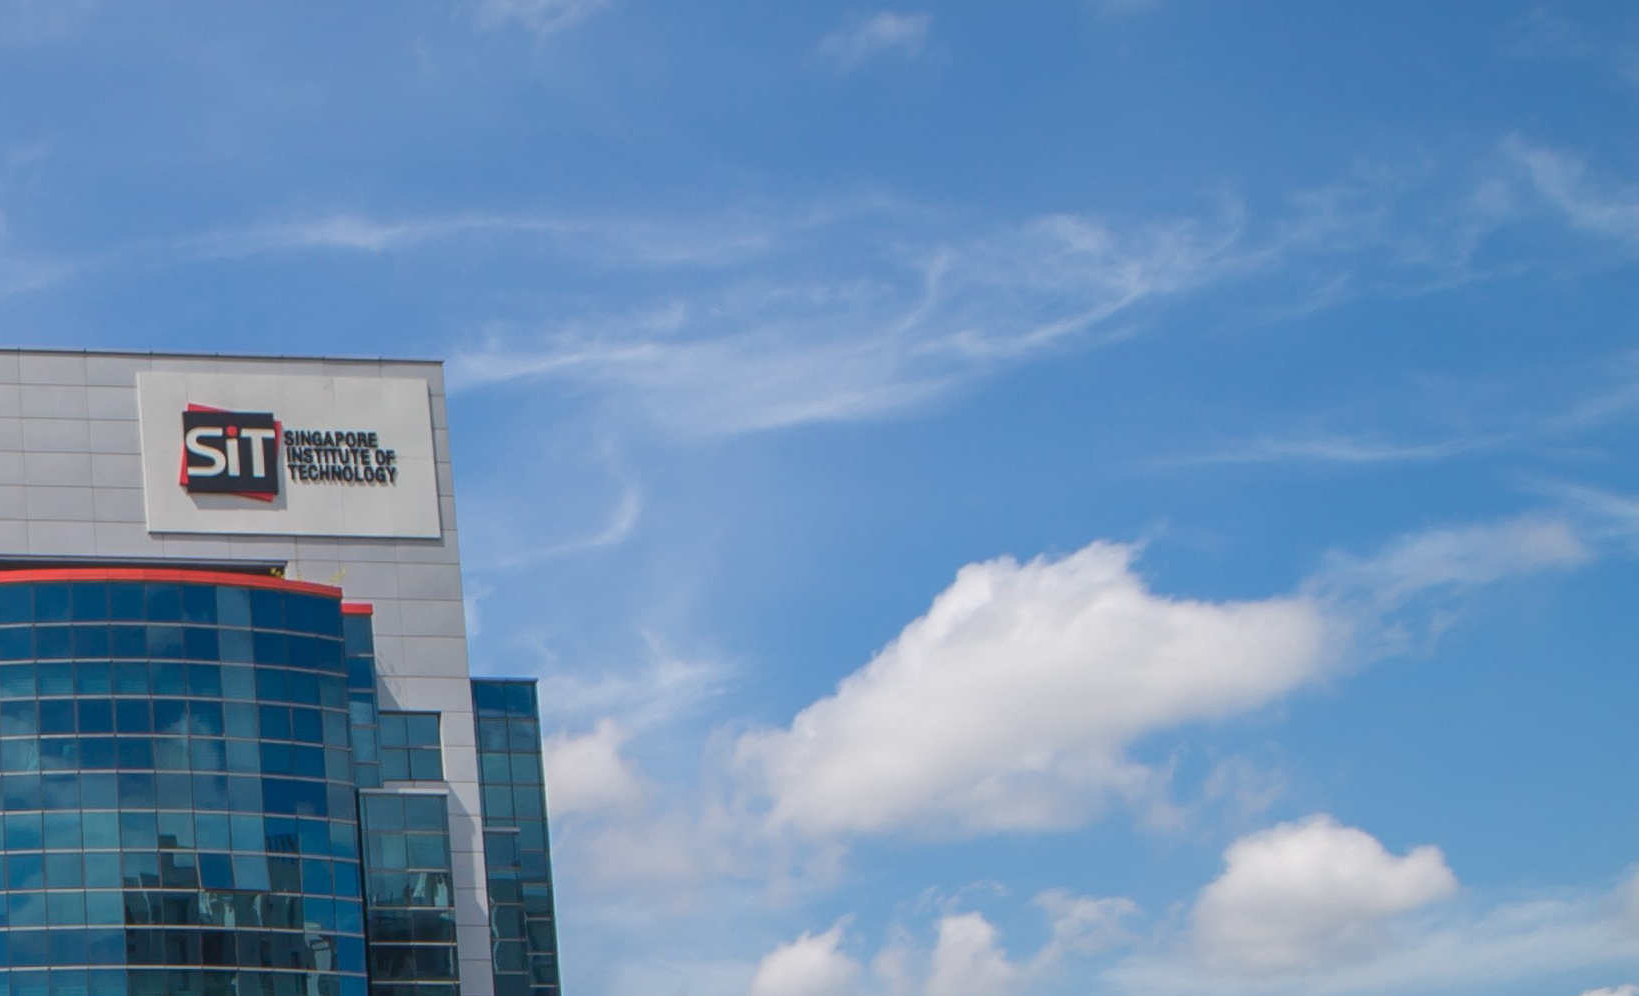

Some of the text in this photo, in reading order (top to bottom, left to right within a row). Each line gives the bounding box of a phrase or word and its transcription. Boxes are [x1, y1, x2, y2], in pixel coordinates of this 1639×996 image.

[283, 430, 378, 448] SINGAPORE
[185, 425, 276, 478] SiT
[286, 447, 396, 465] INSTITUTE OF
[287, 464, 397, 483] TECHNOLOGY
